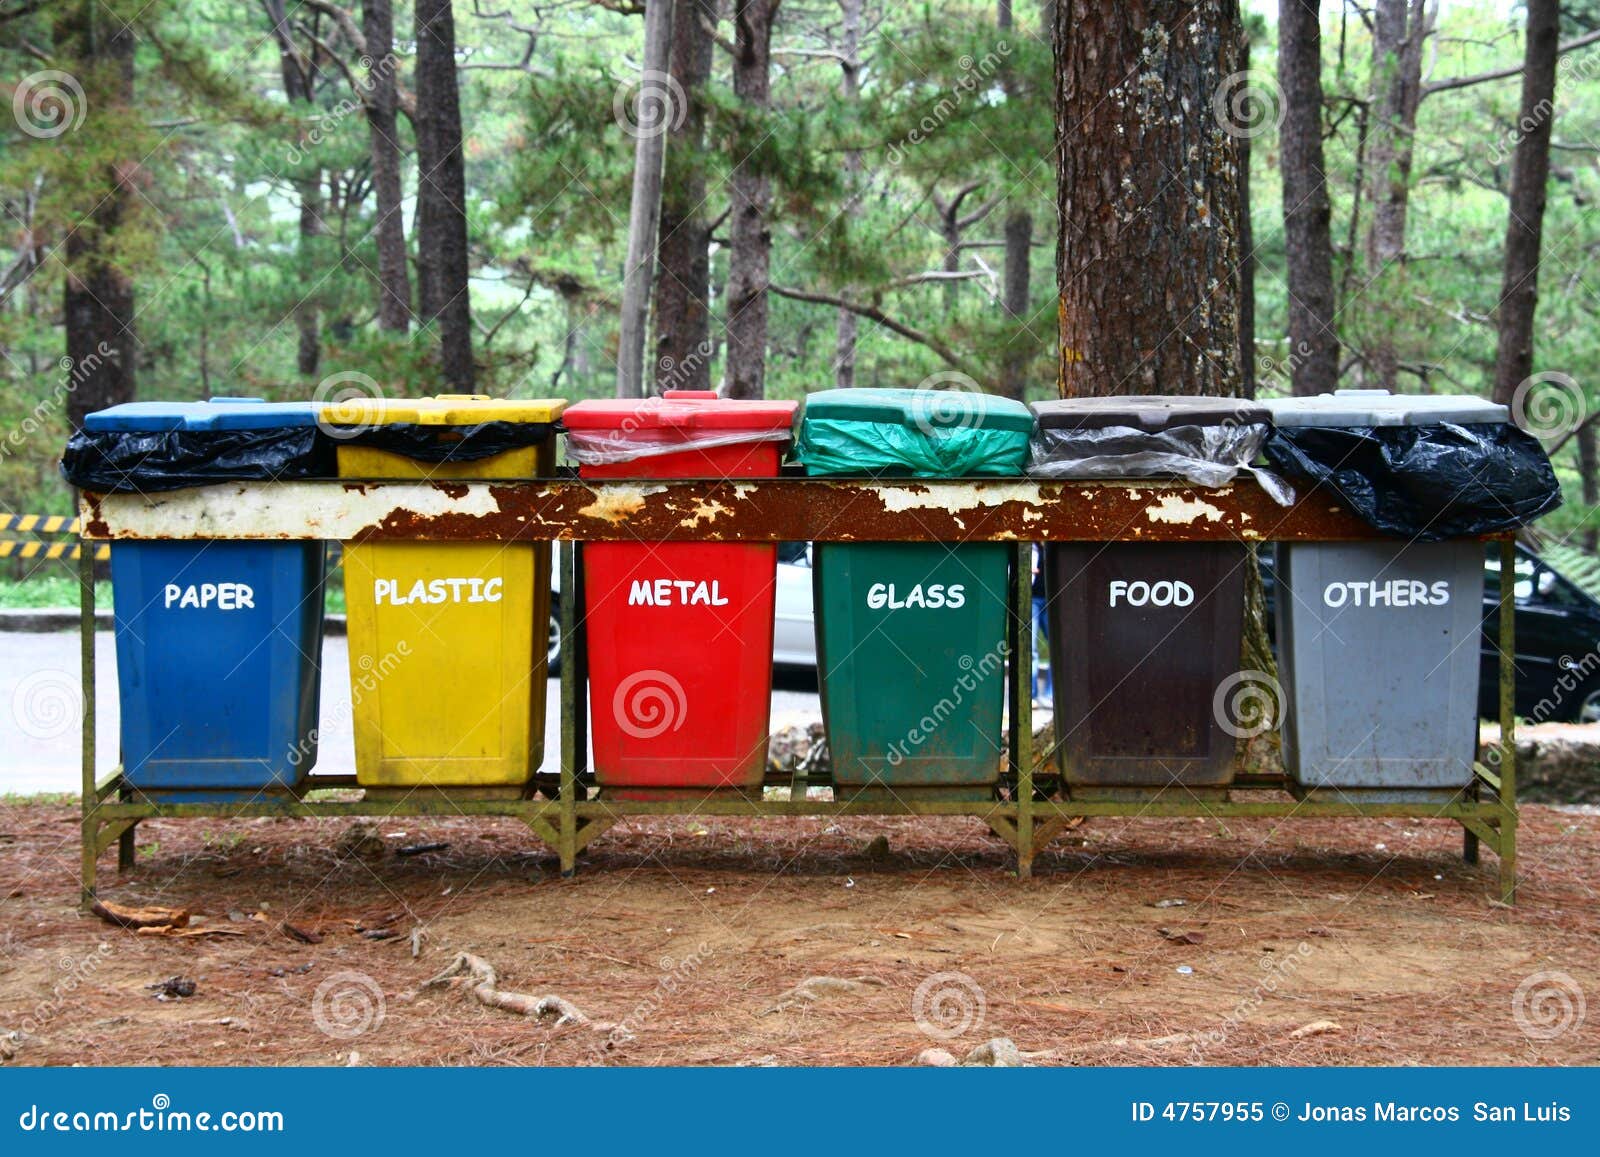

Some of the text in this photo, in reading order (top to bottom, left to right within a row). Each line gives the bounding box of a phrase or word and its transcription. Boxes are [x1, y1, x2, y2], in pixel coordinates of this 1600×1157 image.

[164, 582, 255, 611] PAPER
[374, 577, 503, 608] PLASTIC
[628, 578, 729, 607] METAL
[866, 582, 966, 611] GLASS
[1109, 579, 1195, 608] FOOD
[1323, 579, 1450, 609] OTHERS
